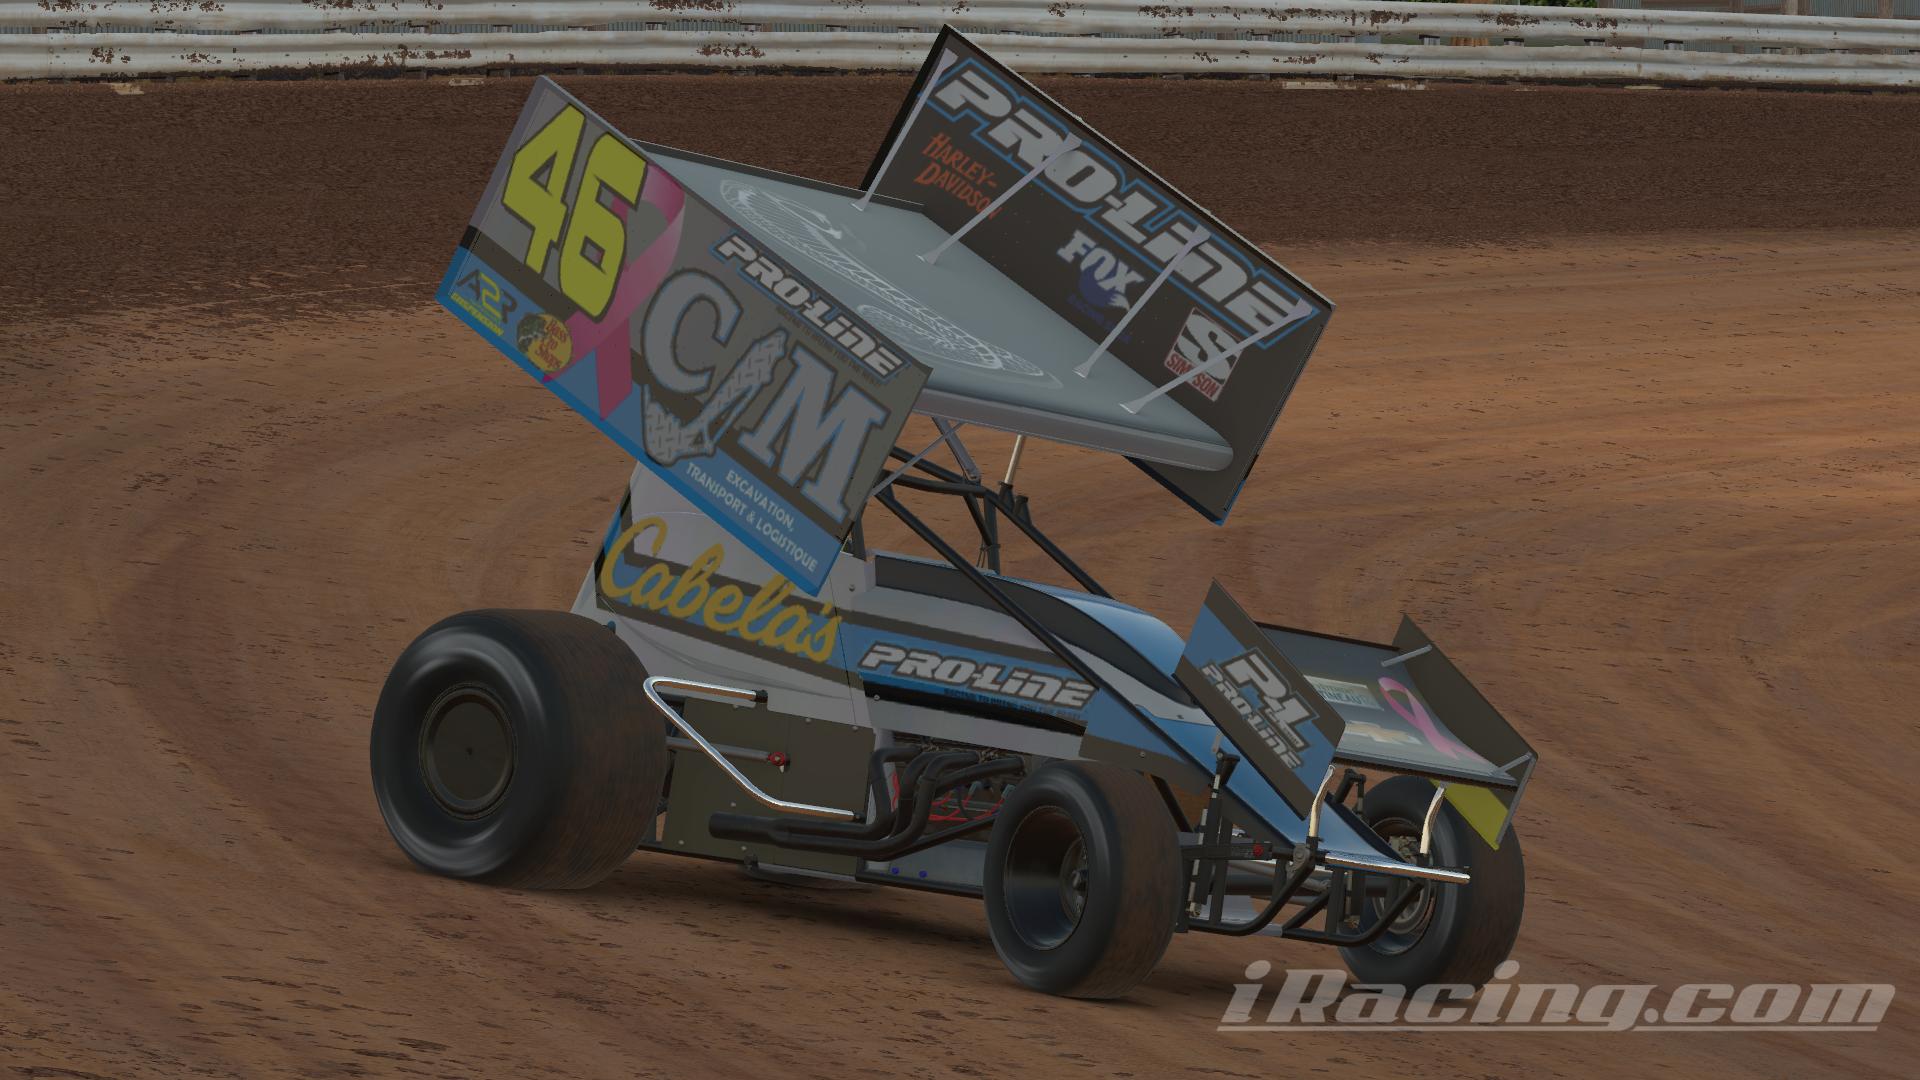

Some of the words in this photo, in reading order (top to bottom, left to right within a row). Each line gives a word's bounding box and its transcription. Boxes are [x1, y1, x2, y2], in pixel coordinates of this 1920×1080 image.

[921, 132, 998, 188] HARLEY-
[502, 102, 648, 323] 46
[1056, 229, 1145, 293] FOX
[1166, 353, 1220, 398] SIMSON
[686, 462, 748, 516] TRANSPORT
[747, 510, 757, 524] &
[755, 518, 819, 573] LOGISTIQUE
[725, 469, 795, 533] EXCAVATION,
[600, 516, 843, 664] Cabela's
